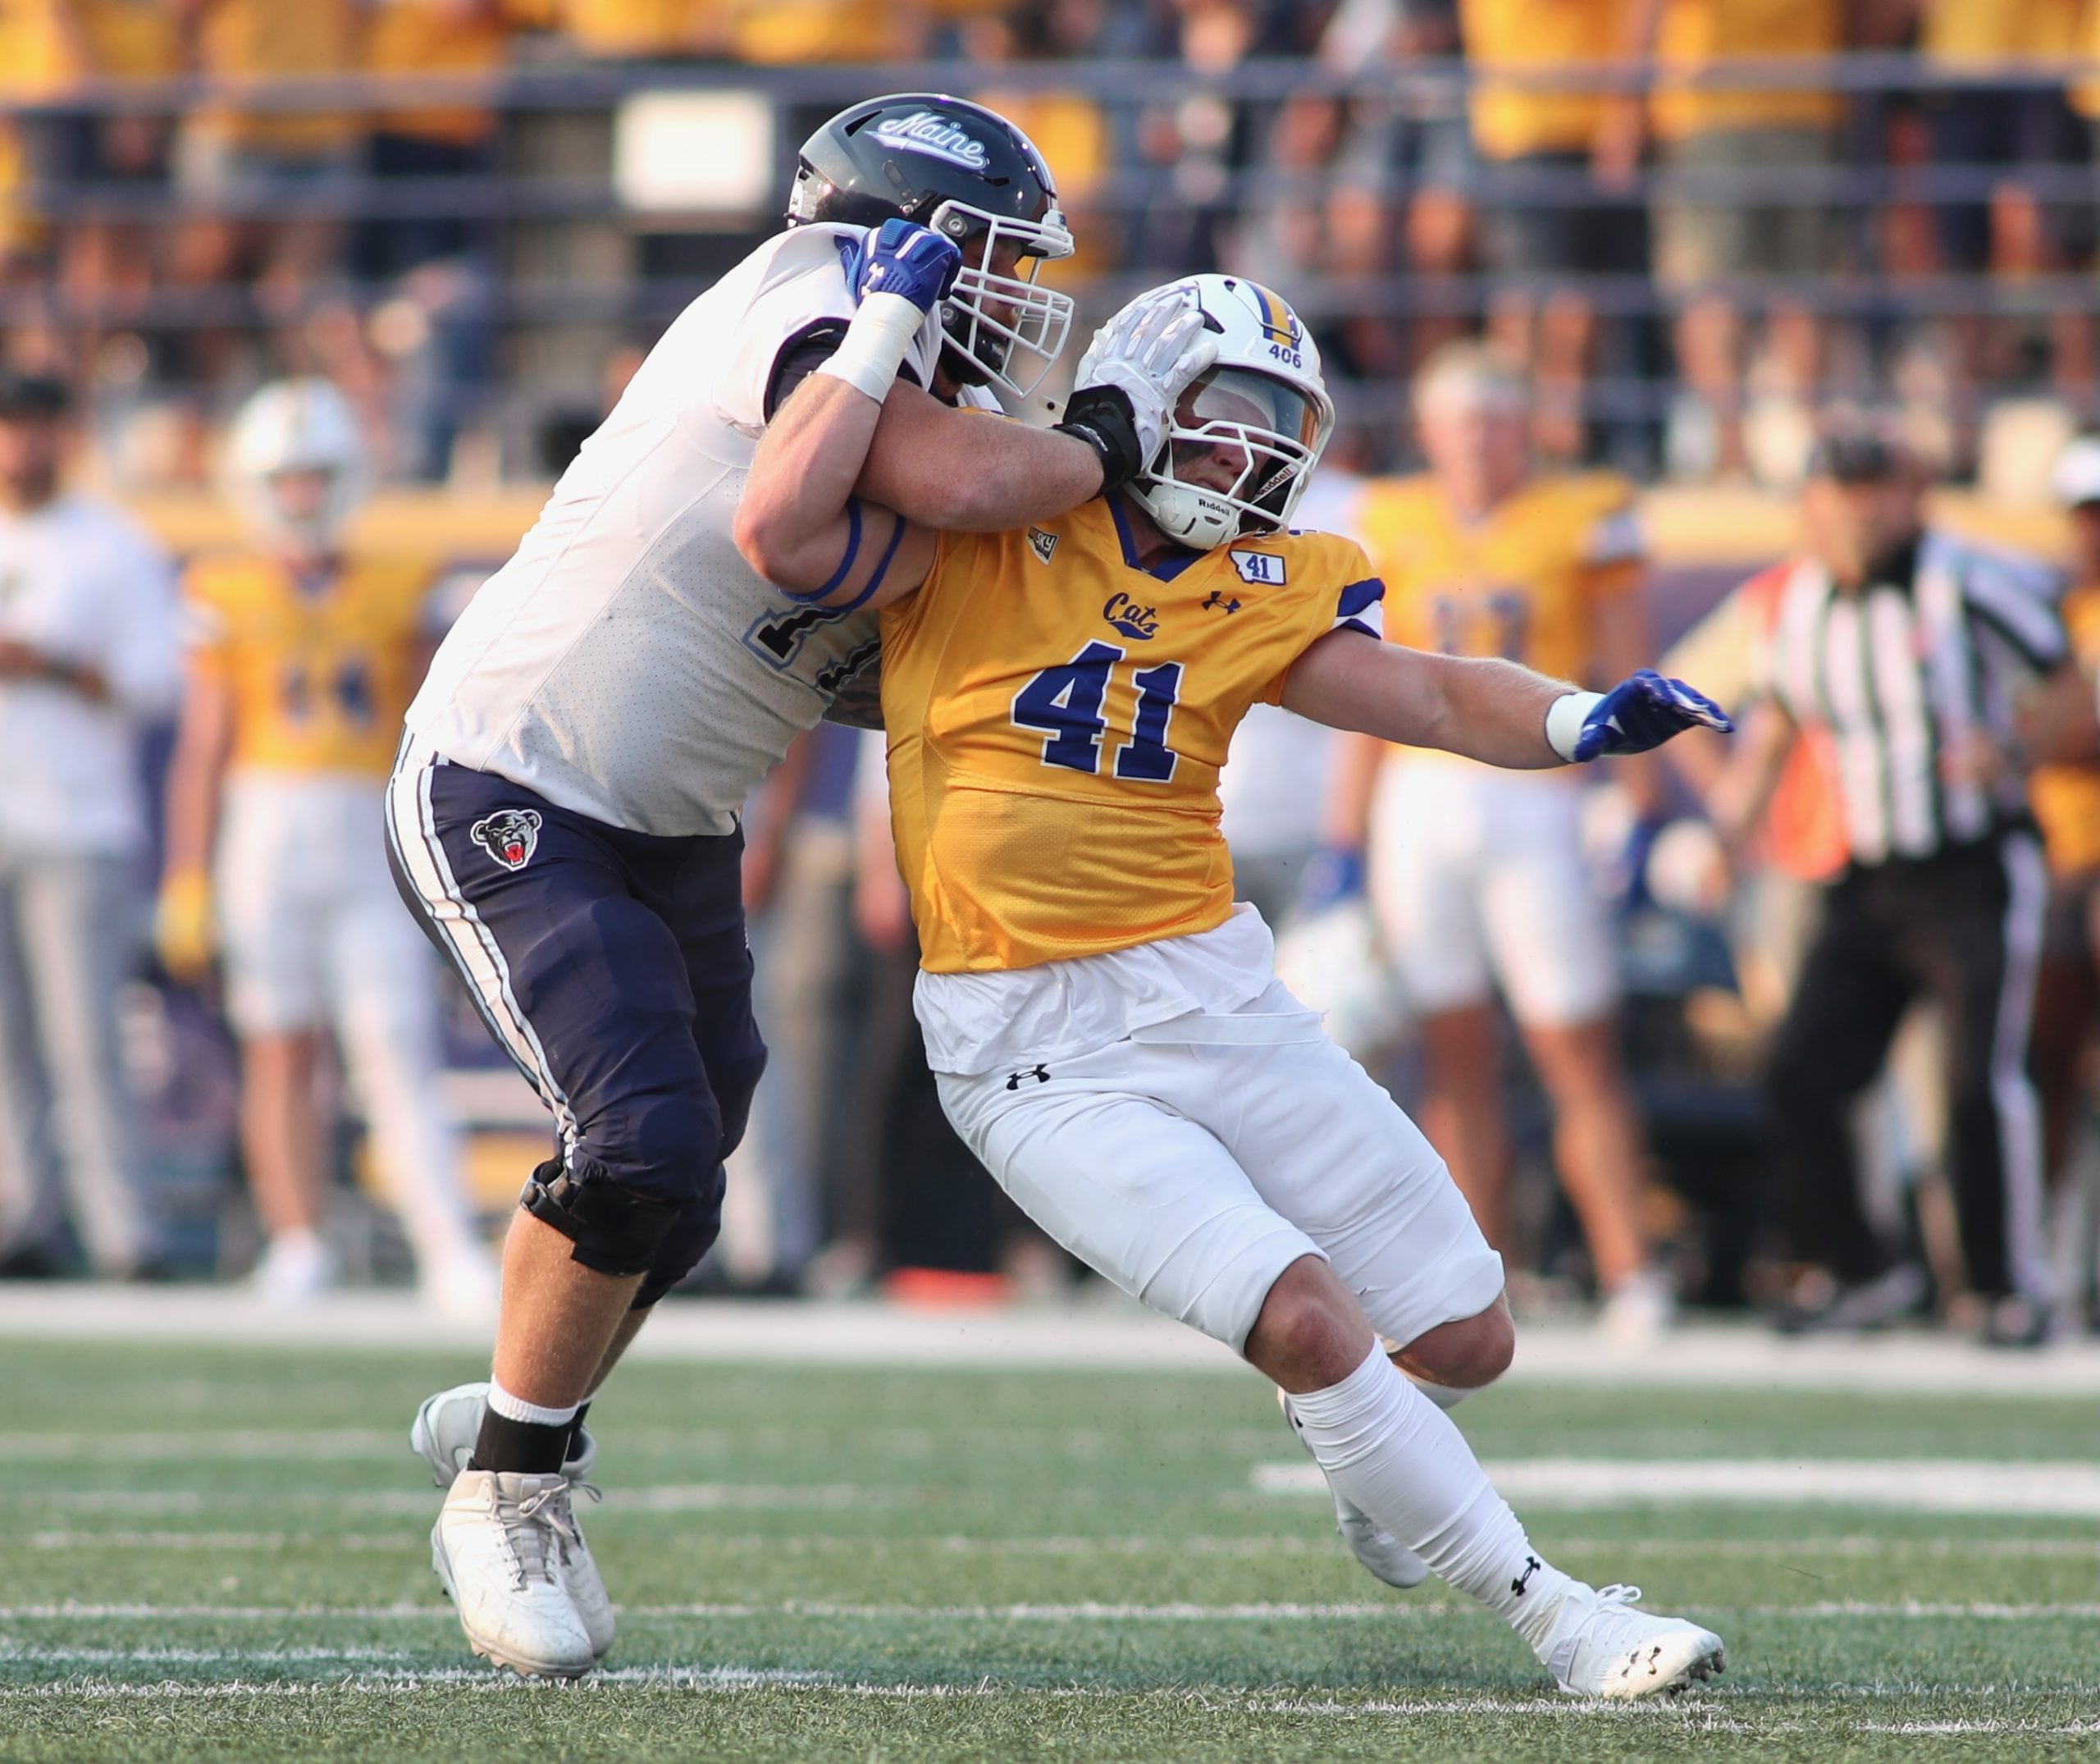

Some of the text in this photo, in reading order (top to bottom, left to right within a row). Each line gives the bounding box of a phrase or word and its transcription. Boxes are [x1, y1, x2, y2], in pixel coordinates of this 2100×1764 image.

[876, 111, 986, 167] Maine
[1268, 343, 1303, 370] 406
[1246, 555, 1271, 579] 41
[1102, 592, 1160, 634] Cats
[1010, 638, 1186, 784] 41
